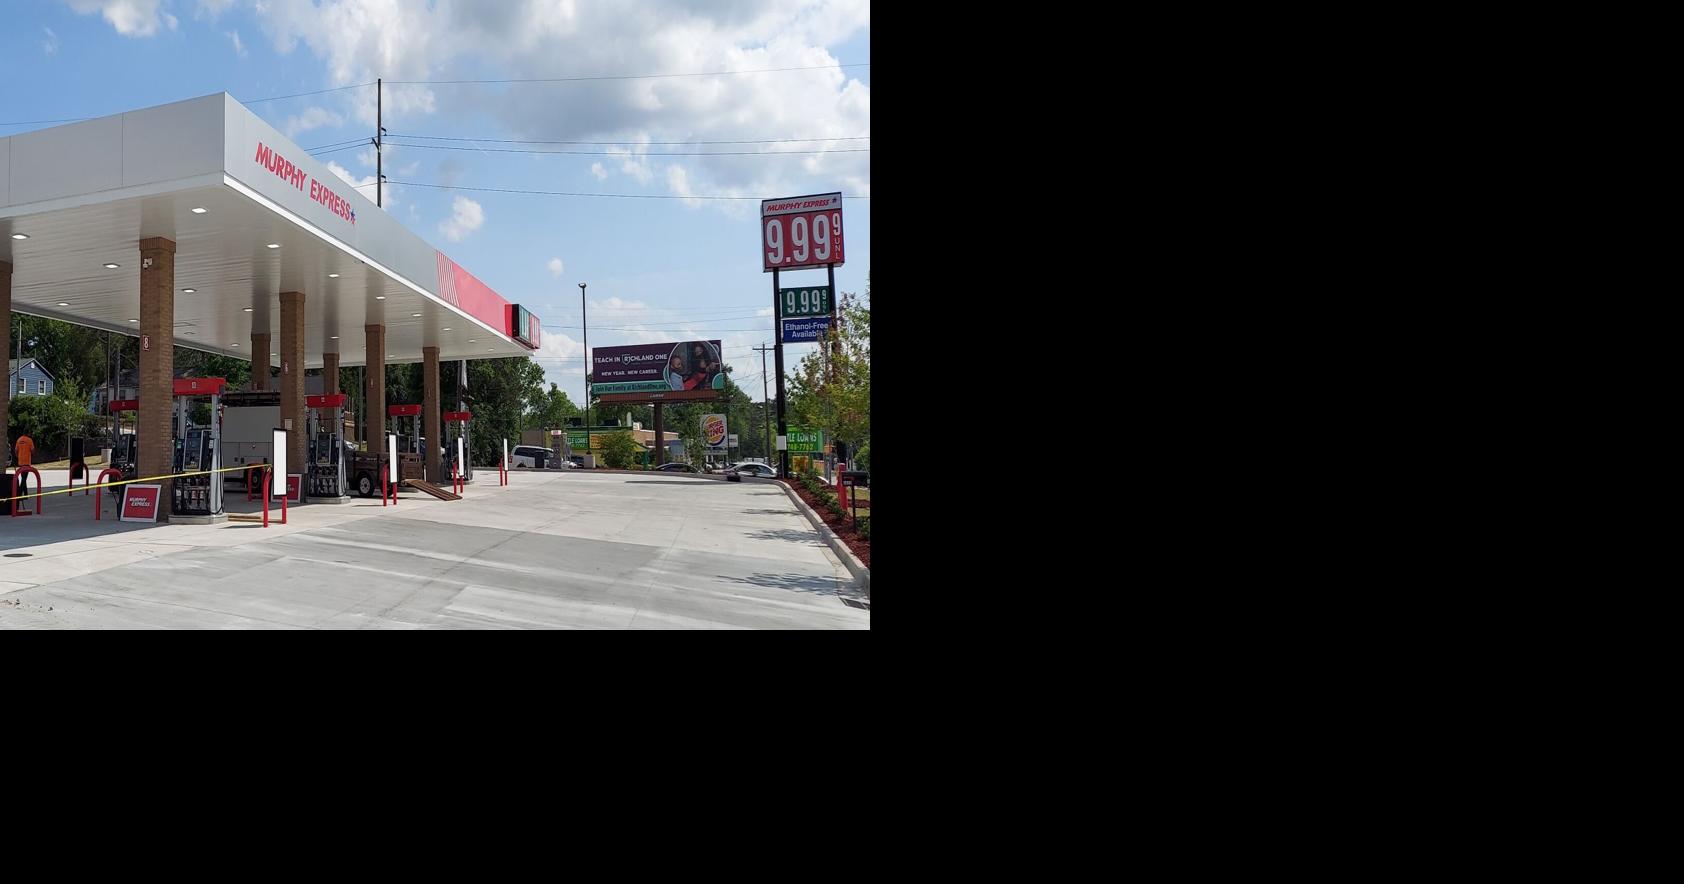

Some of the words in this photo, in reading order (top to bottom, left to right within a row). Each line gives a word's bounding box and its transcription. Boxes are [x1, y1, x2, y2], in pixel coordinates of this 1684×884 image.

[255, 142, 307, 192] MURPHY
[310, 178, 351, 221] EXPRESS
[766, 202, 803, 212] MURPHY
[803, 199, 829, 208] EXPRESS
[766, 214, 831, 264] 9.99
[786, 289, 821, 314] 9.99
[785, 322, 829, 331] Ethanol-Free
